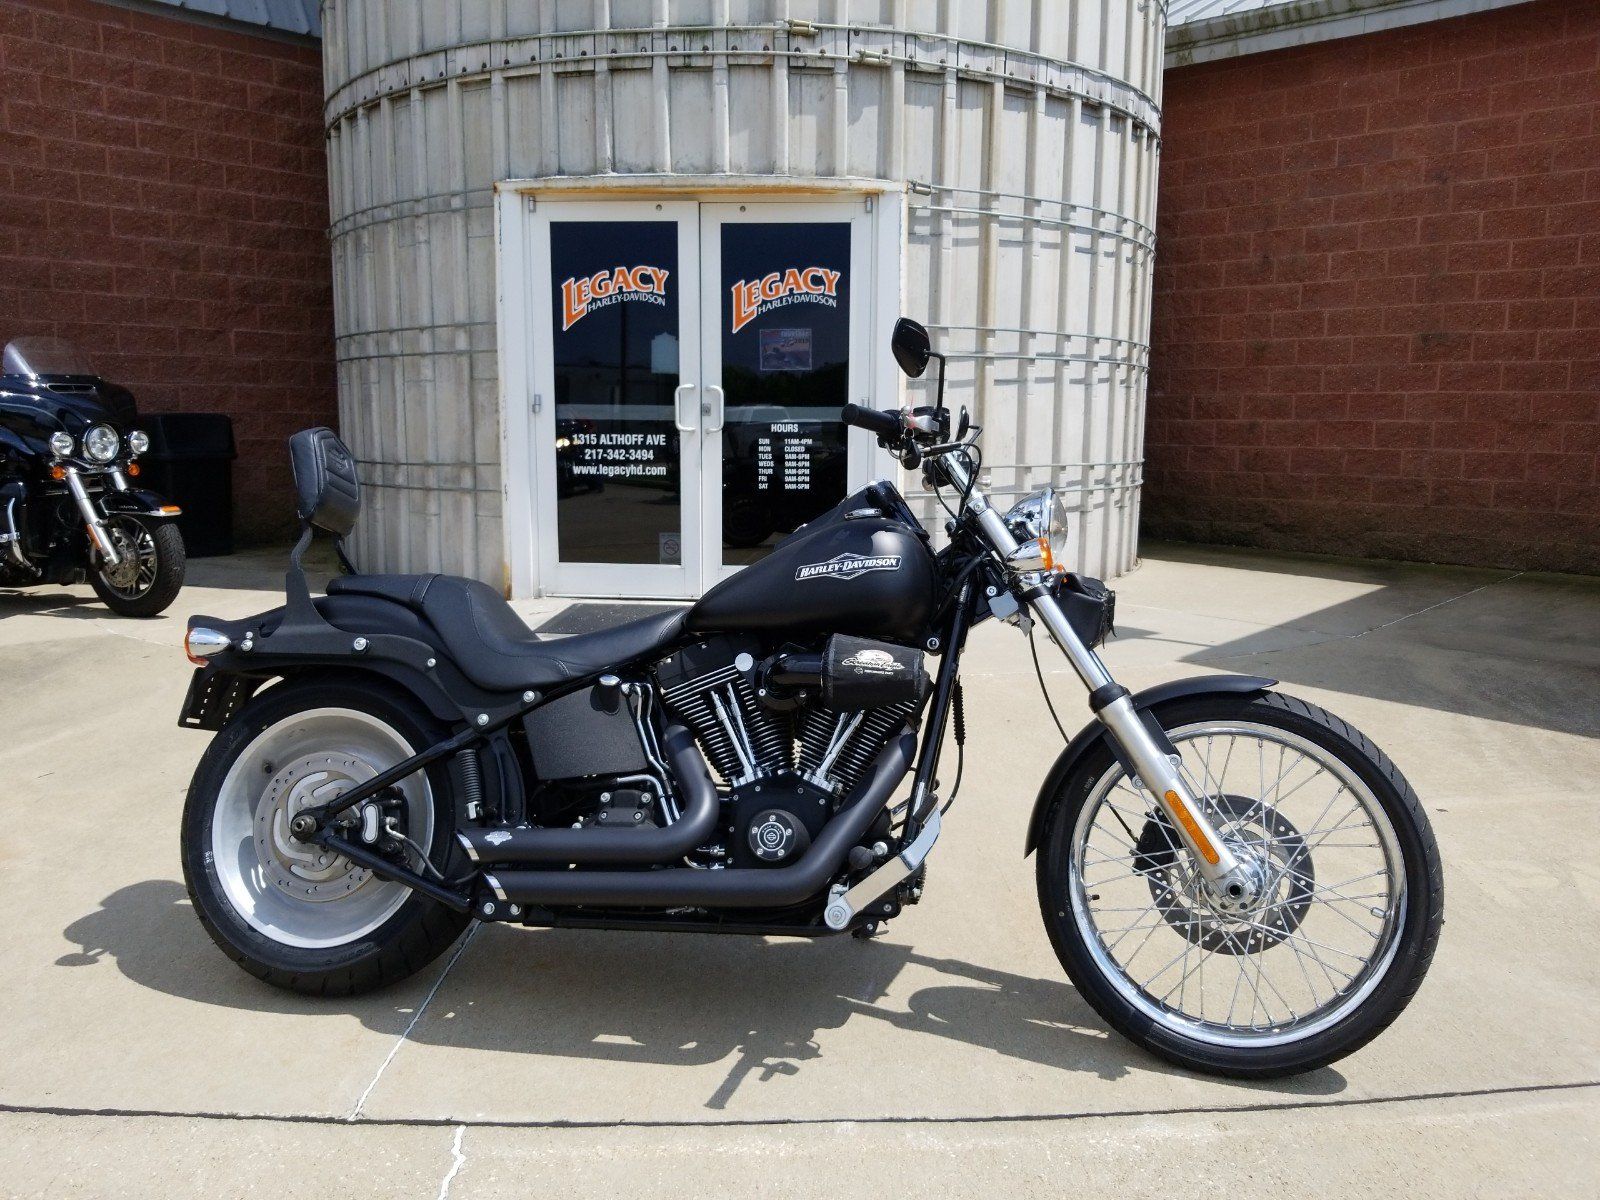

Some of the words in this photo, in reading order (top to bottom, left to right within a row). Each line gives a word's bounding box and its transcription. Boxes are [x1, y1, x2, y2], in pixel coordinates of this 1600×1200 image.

[562, 265, 669, 331] LEGACY
[587, 292, 666, 313] HARLEY-DAVIDSON
[731, 267, 841, 333] LEGACY
[757, 293, 837, 315] HARLEY-DAVIDSON
[771, 423, 799, 433] HOURS
[572, 433, 597, 445] 1315
[600, 434, 644, 446] ALTHOFF
[646, 434, 666, 446] AVE
[584, 449, 654, 460] 217-342-3494
[572, 464, 666, 477] www.legacyhd.com
[799, 558, 898, 578] HARLEY-DAVIDSON
